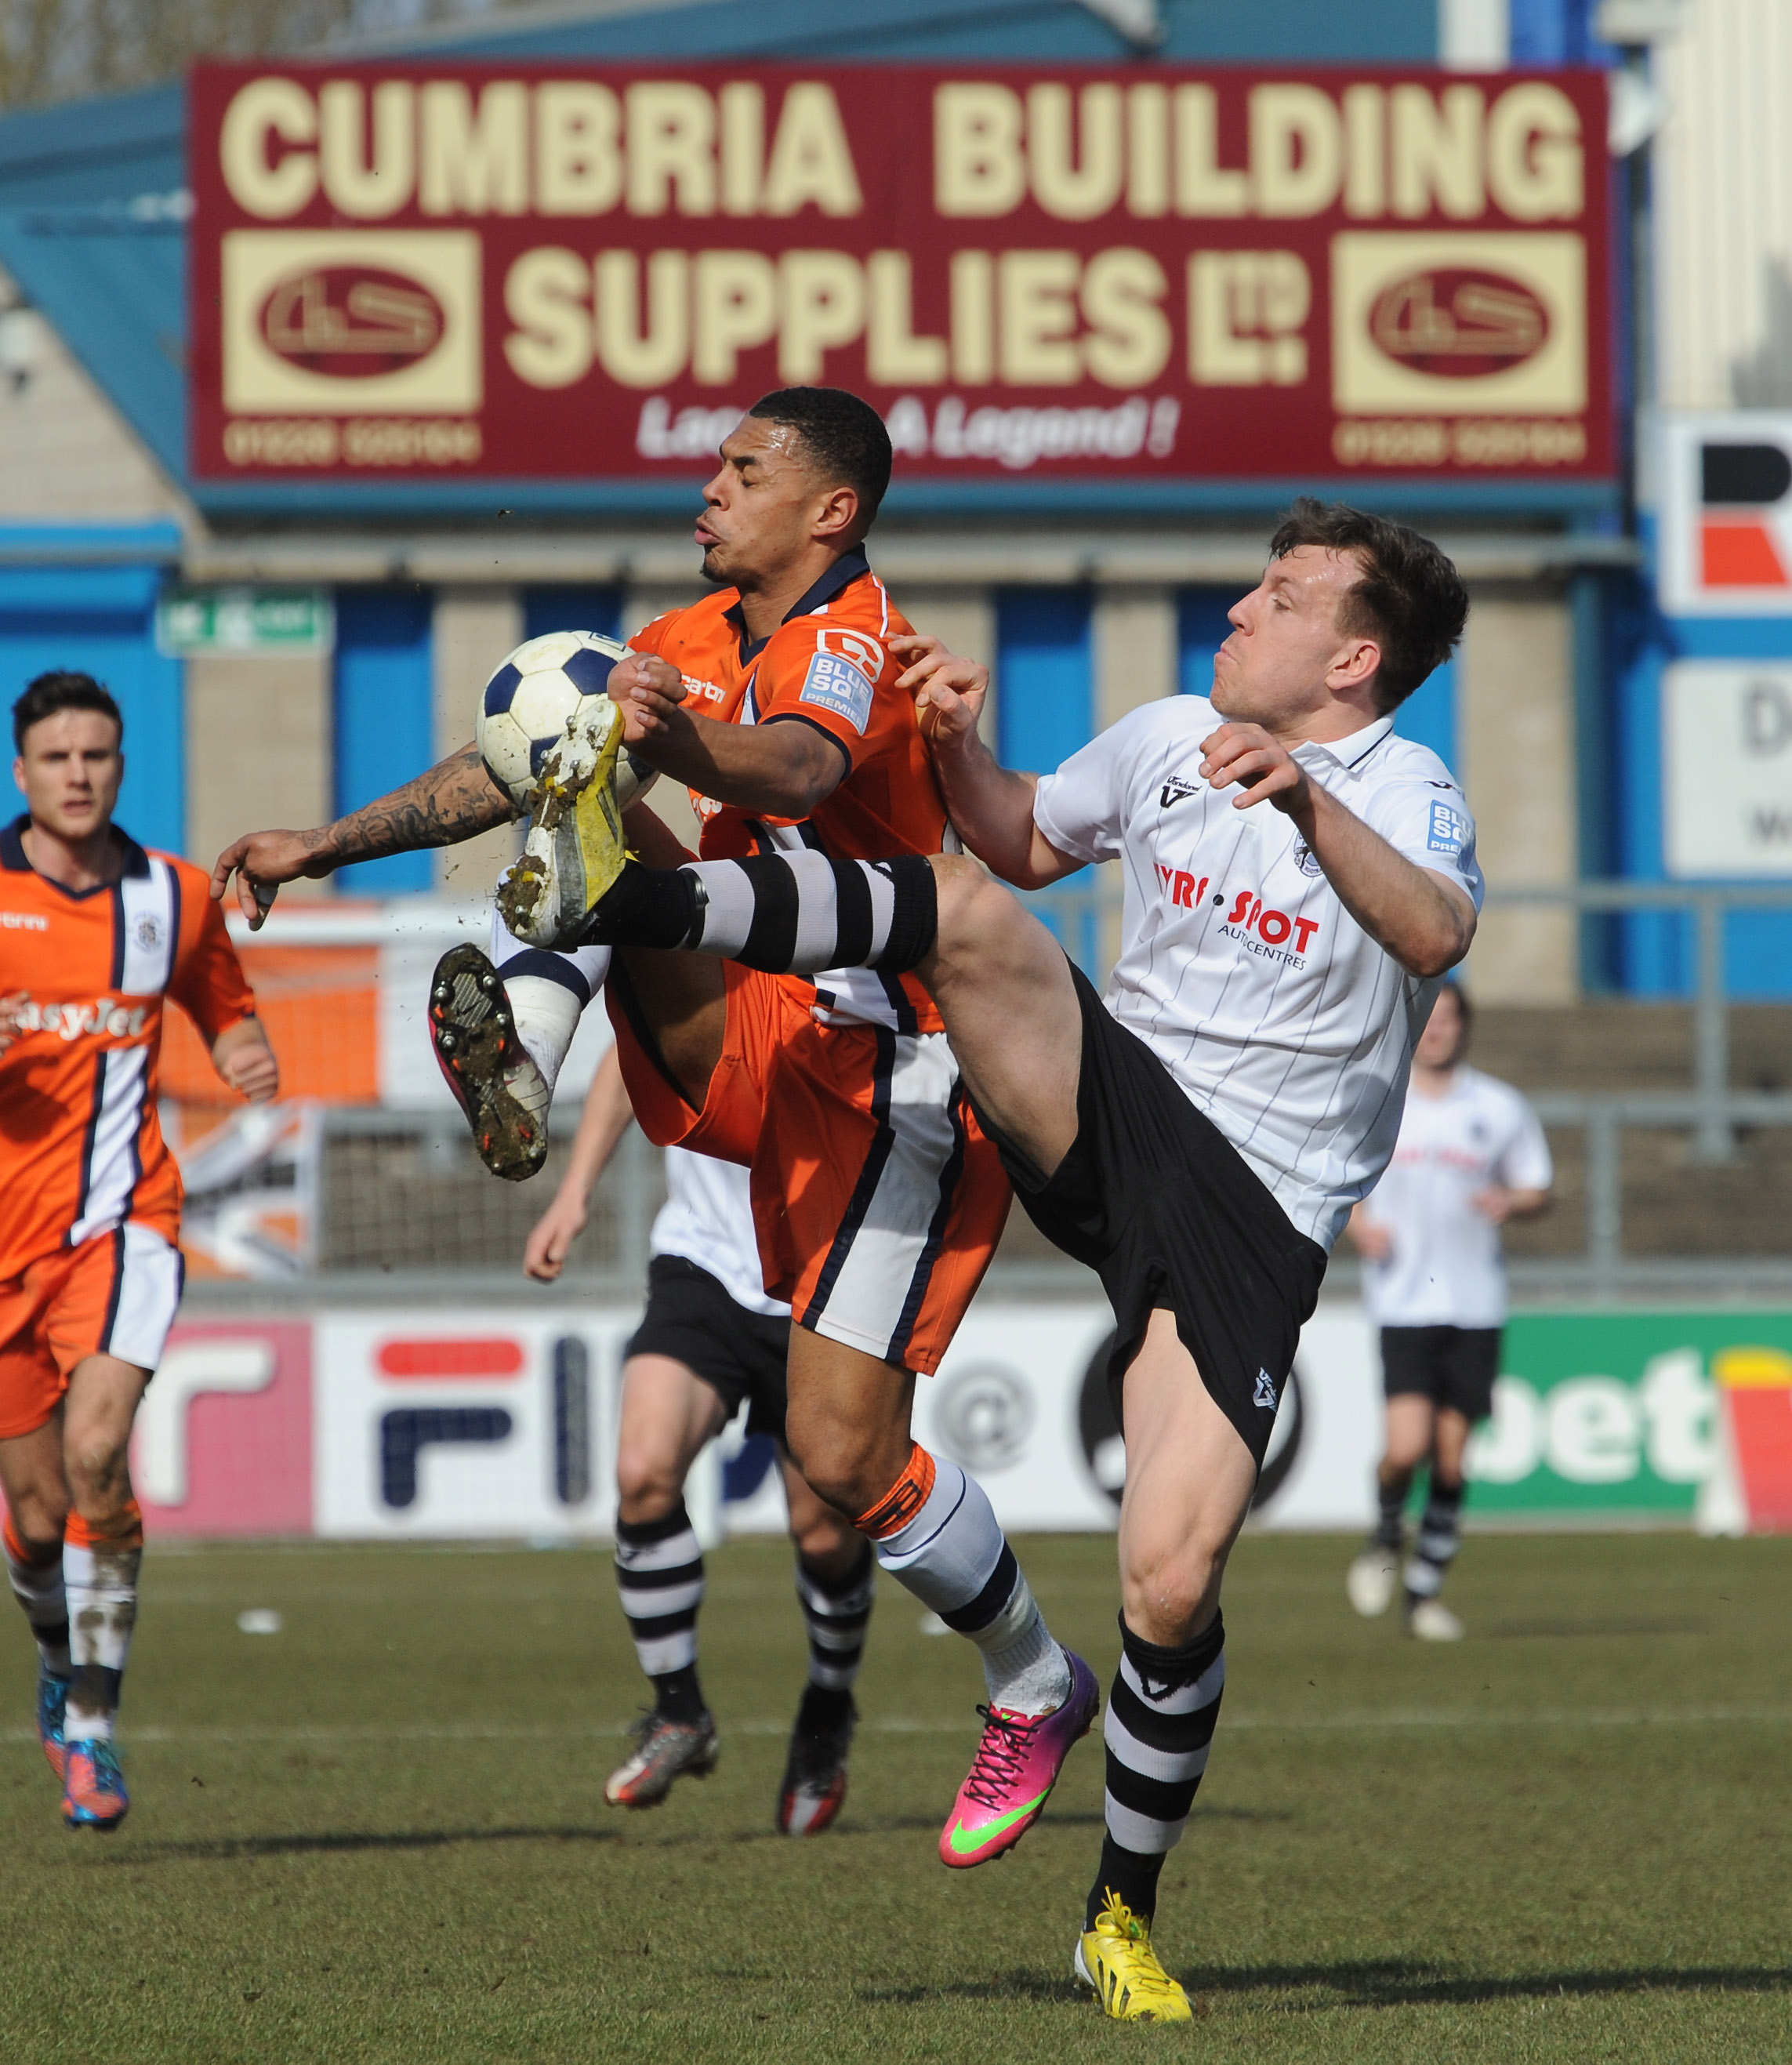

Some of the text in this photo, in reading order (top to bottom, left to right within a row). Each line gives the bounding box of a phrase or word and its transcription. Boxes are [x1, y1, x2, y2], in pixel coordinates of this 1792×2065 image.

[222, 77, 1585, 222] CUMBRIA BUILDING
[503, 245, 1173, 389] SUPPLIES
[811, 673, 852, 700] SQ
[815, 657, 869, 702] BLUE
[806, 692, 863, 729] PREMIER
[1431, 840, 1460, 854] PRE
[1228, 891, 1320, 953] SPOT
[1217, 925, 1307, 971] AUTOCENTRES
